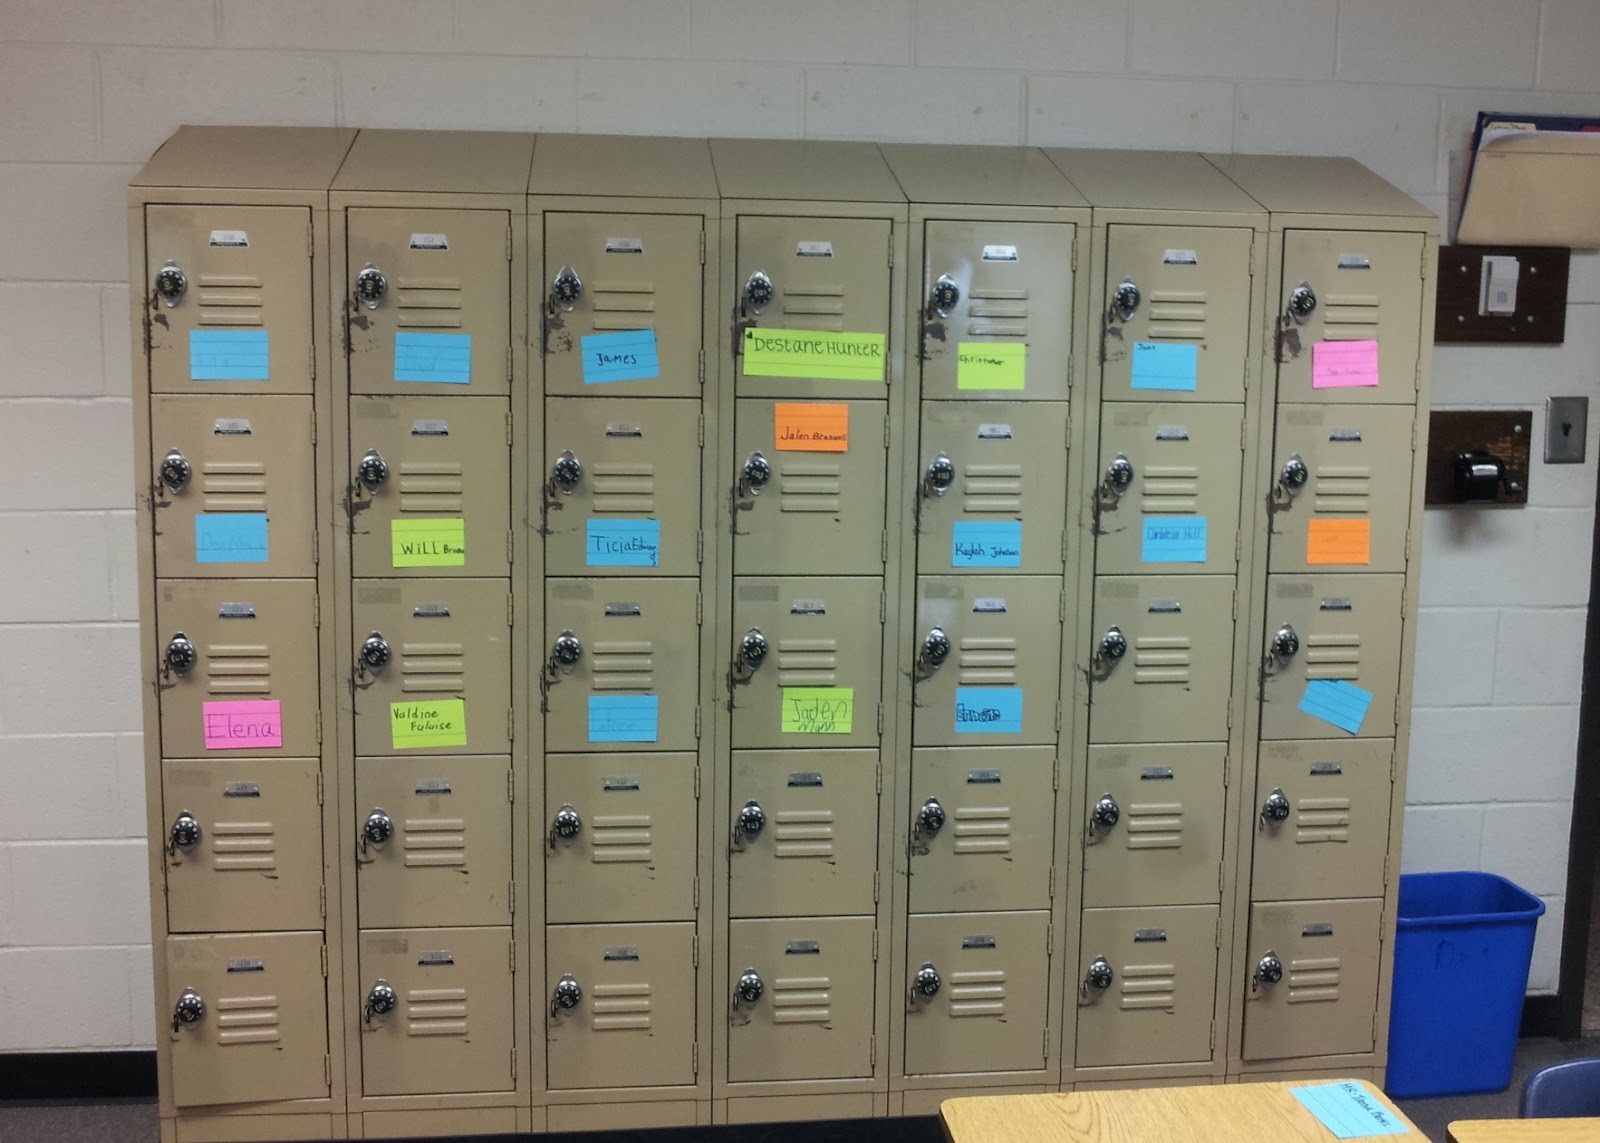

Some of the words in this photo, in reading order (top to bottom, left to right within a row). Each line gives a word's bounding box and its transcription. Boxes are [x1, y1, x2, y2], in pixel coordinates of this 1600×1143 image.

[596, 353, 637, 367] James
[781, 427, 810, 441] Jalen
[791, 698, 848, 722] Jaden
[207, 714, 275, 739] Elena
